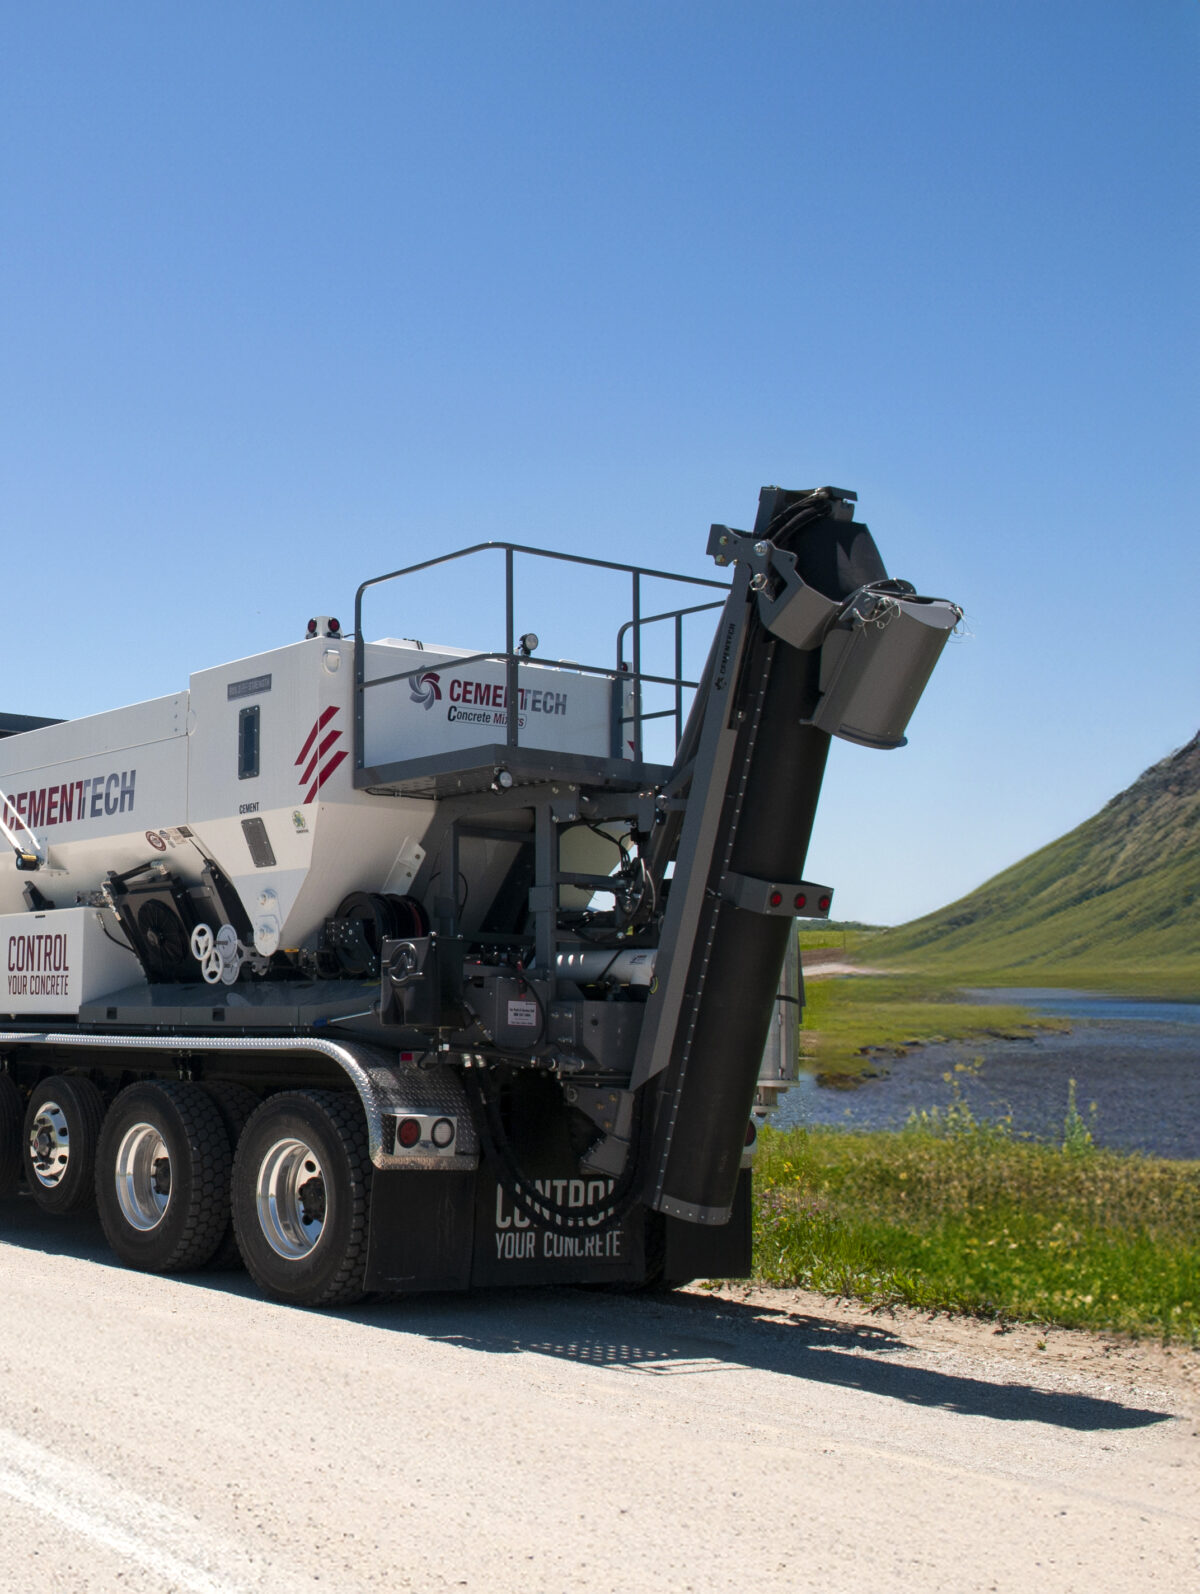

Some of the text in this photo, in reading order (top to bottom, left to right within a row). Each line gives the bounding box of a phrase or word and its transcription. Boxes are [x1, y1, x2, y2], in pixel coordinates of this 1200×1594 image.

[449, 679, 568, 716] CEMETECH
[447, 705, 492, 723] Concrete
[3, 769, 137, 833] CEMENTECH
[239, 802, 259, 814] CEMENT
[8, 933, 69, 972] CONTROL
[8, 974, 69, 996] YOUR CONCRETE
[495, 1230, 622, 1259] YOUR CONCRETE
